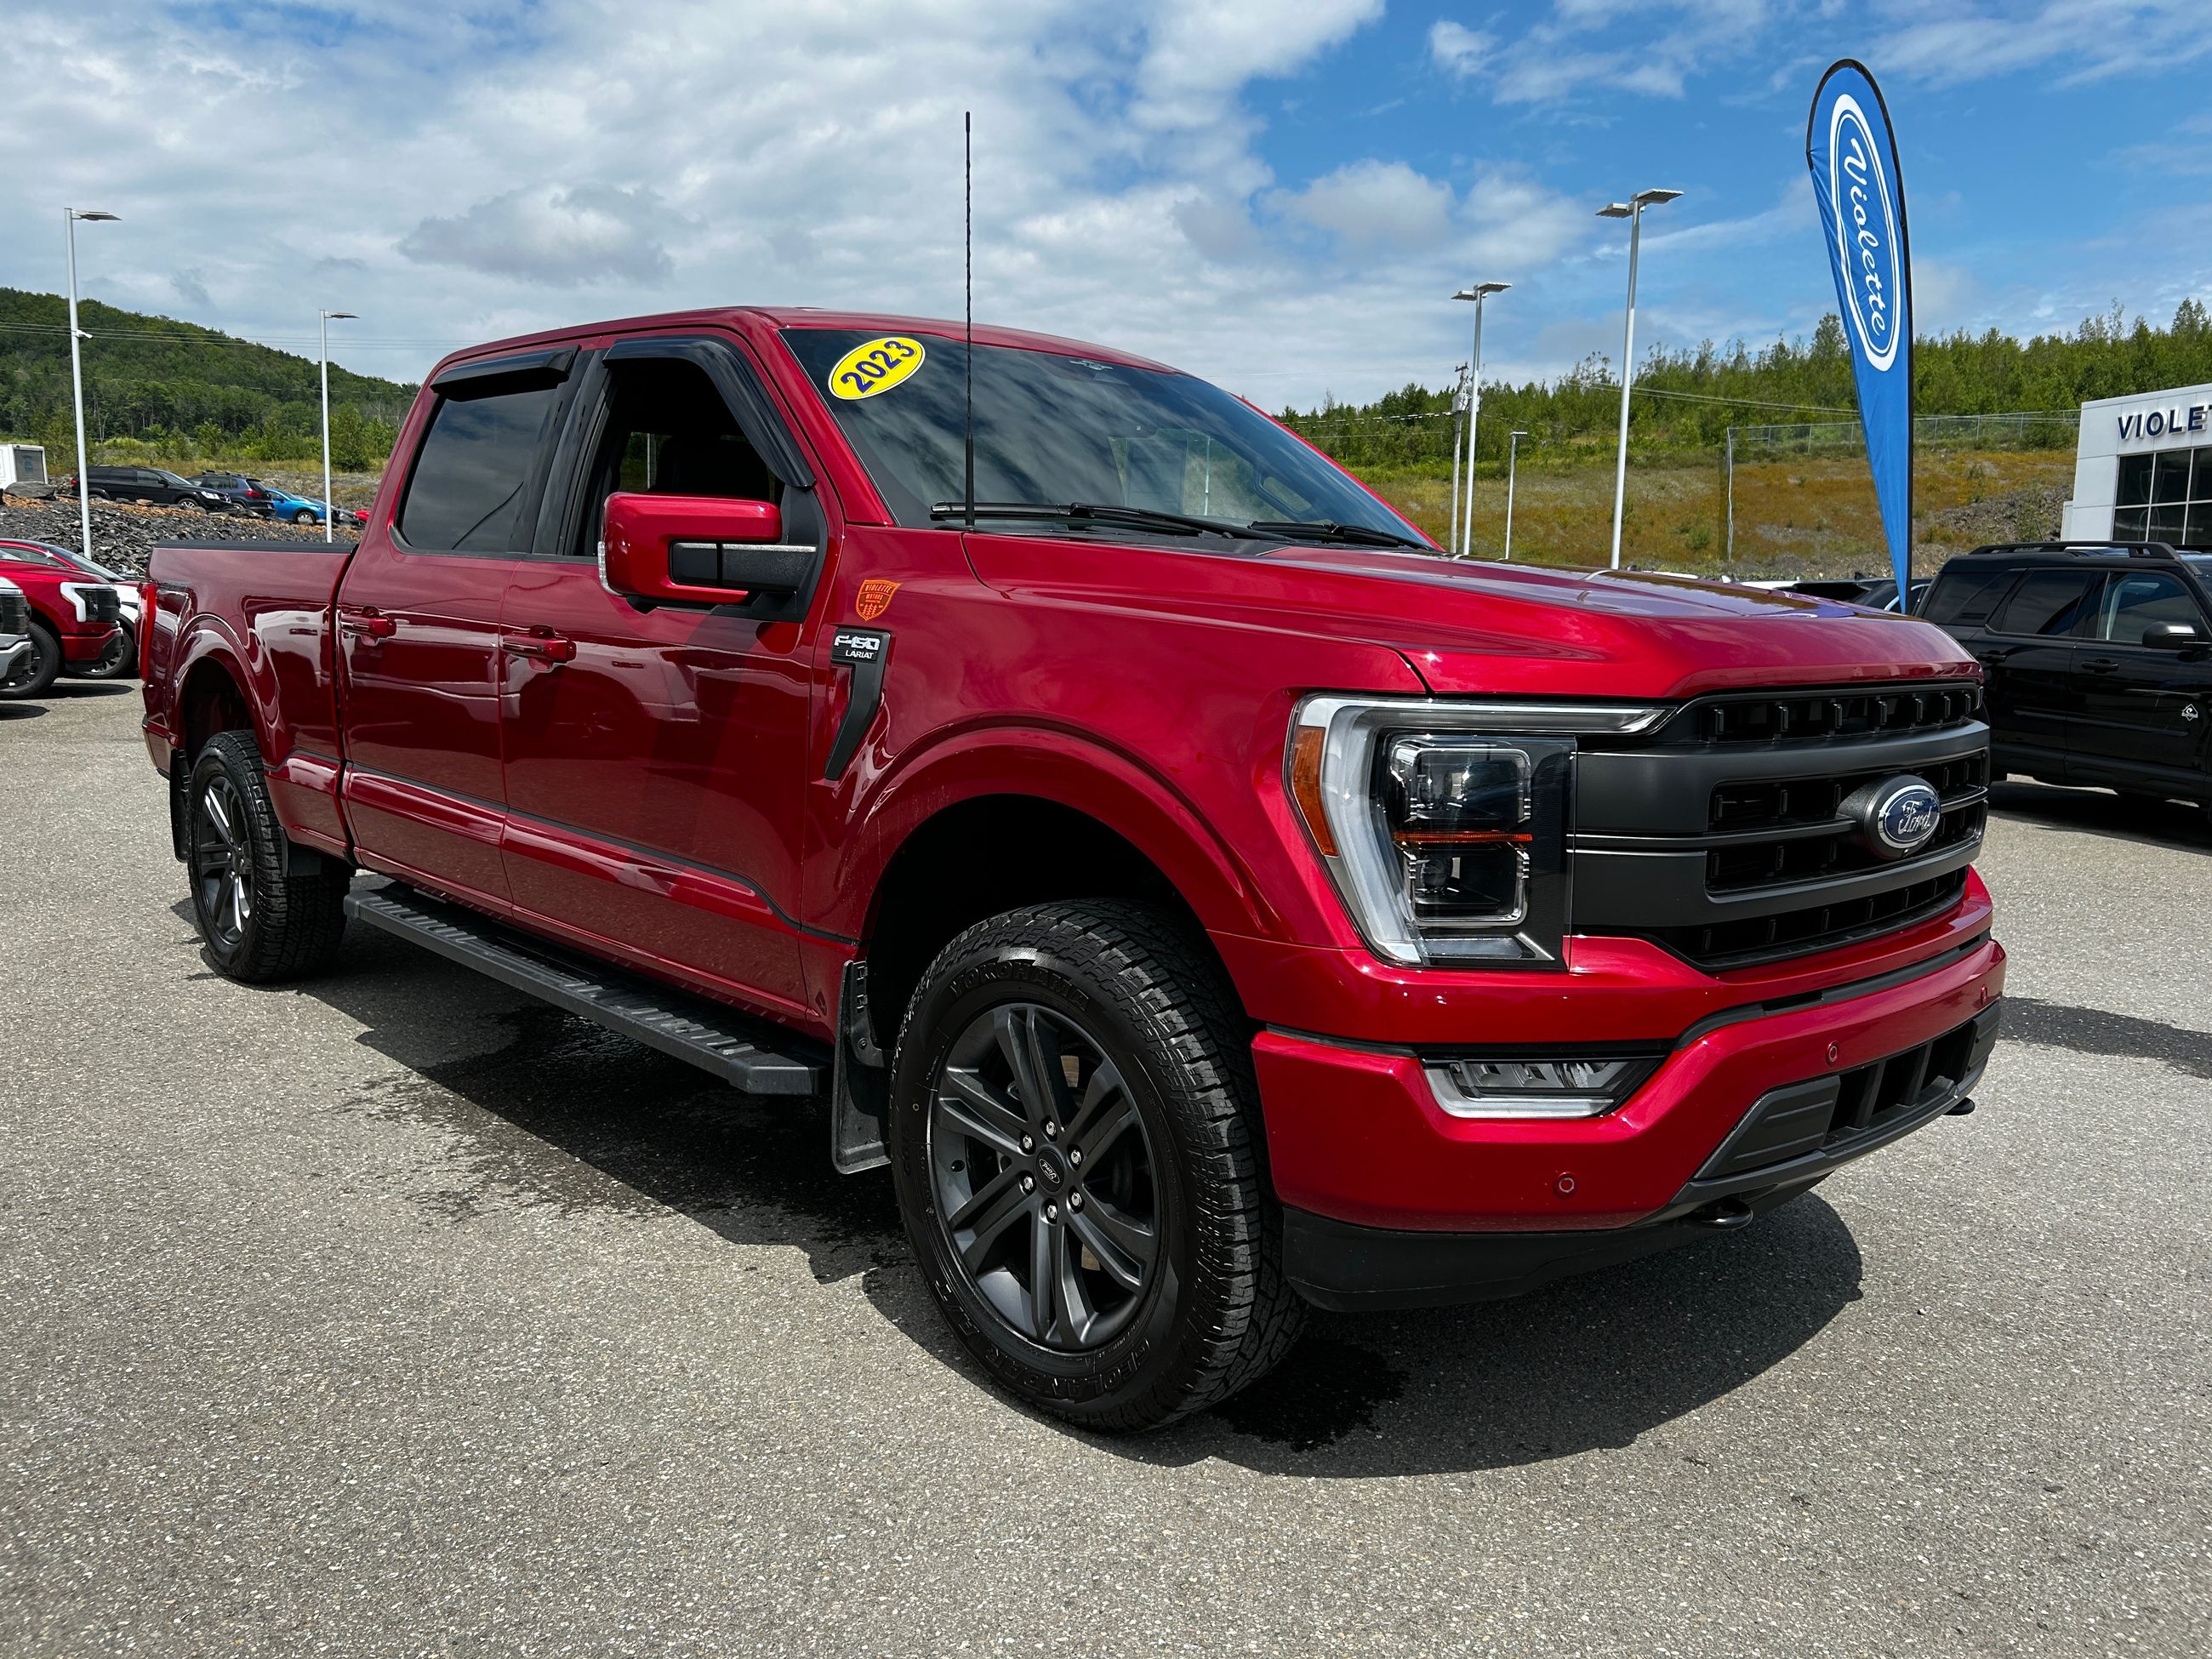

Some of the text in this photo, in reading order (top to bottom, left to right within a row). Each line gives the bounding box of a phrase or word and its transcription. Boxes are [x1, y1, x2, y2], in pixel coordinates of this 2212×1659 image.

[1844, 138, 1889, 338] Violette
[841, 340, 915, 394] 2023
[2118, 404, 2212, 439] VIOLE
[864, 584, 893, 594] VIOLETTE
[865, 593, 884, 601] MOTORS
[845, 649, 874, 659] LARIAT
[1897, 800, 1932, 835] Ford
[949, 960, 1090, 1012] YOKOHAMA
[1042, 1162, 1057, 1180] Ford
